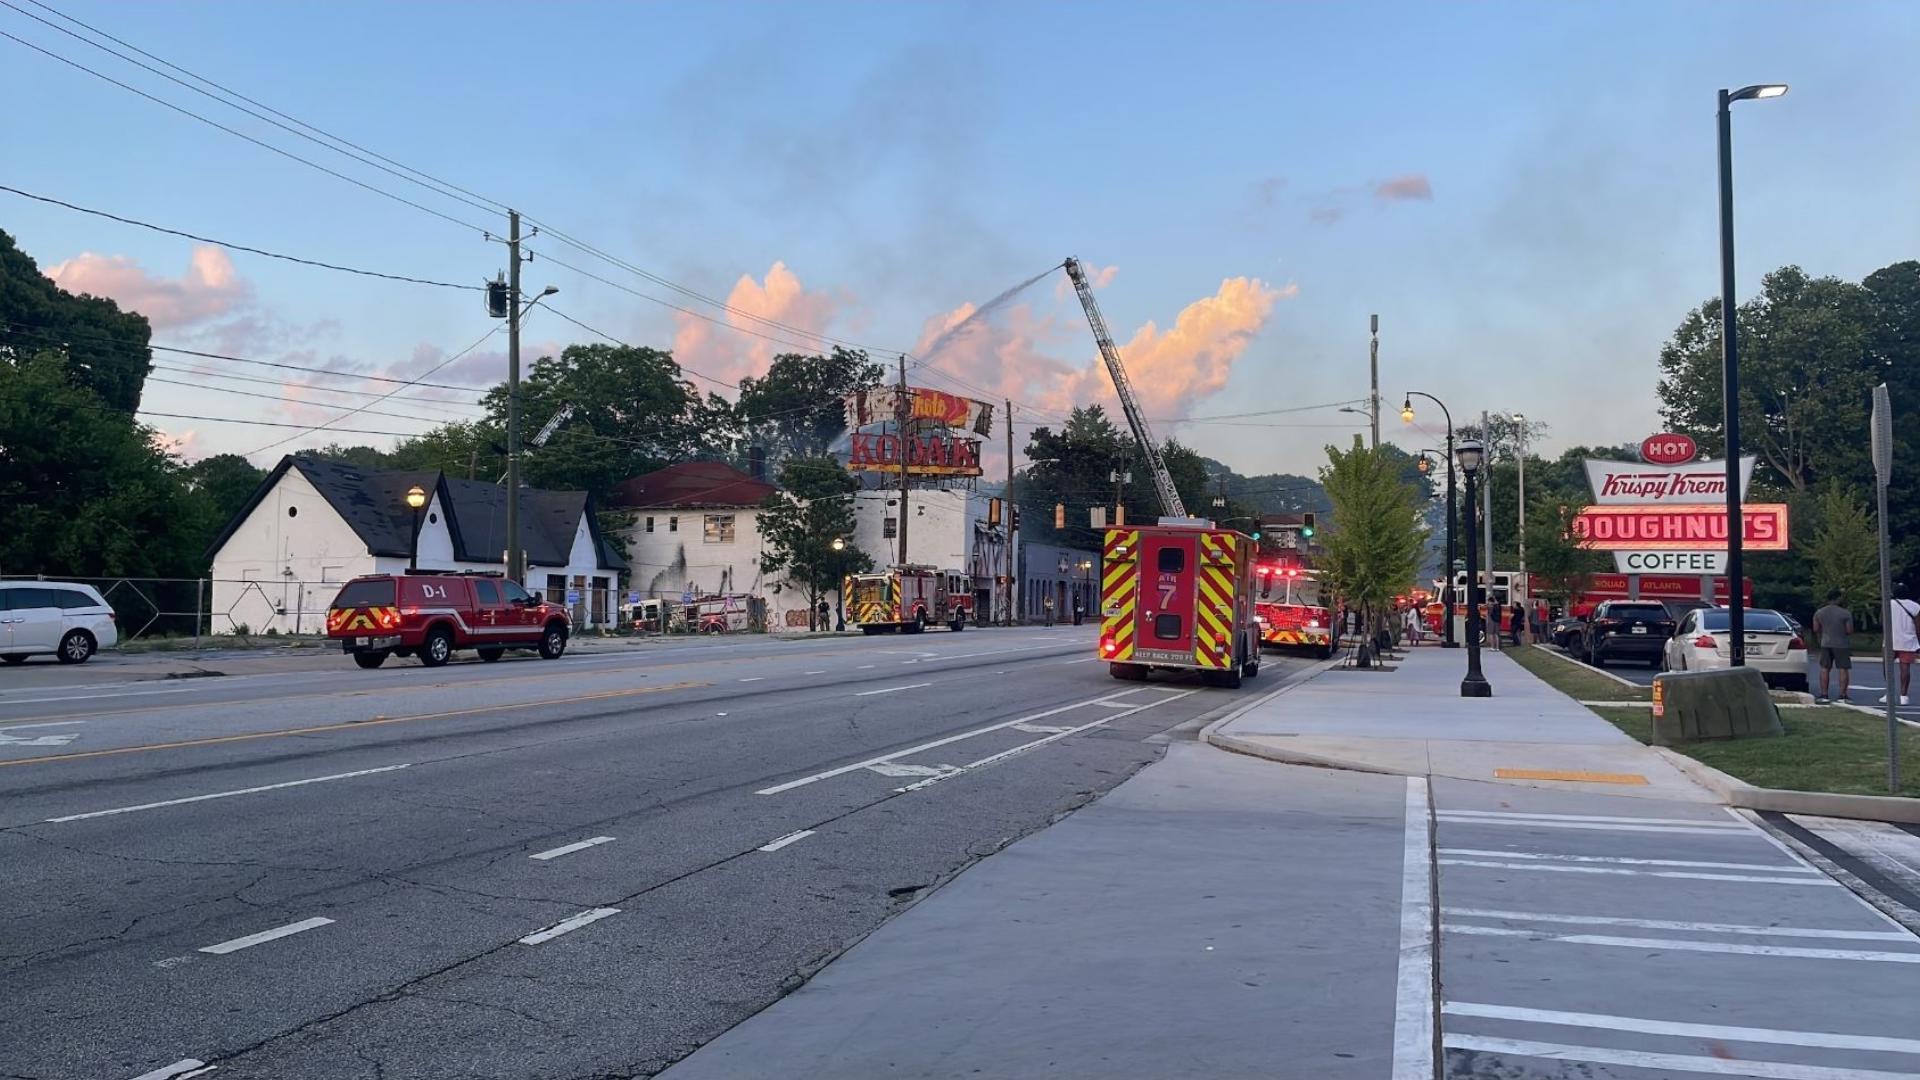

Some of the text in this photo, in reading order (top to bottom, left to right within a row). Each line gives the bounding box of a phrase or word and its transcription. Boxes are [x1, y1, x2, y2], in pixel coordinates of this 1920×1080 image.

[851, 433, 979, 466] KODAK
[1649, 442, 1688, 456] HOT
[1601, 473, 1727, 499] Krispy Krem
[1627, 553, 1715, 569] COFFEE
[1158, 574, 1177, 583] AIR
[1643, 581, 1682, 590] ATLANTA
[422, 584, 447, 598] D-1
[1158, 585, 1177, 610] 7
